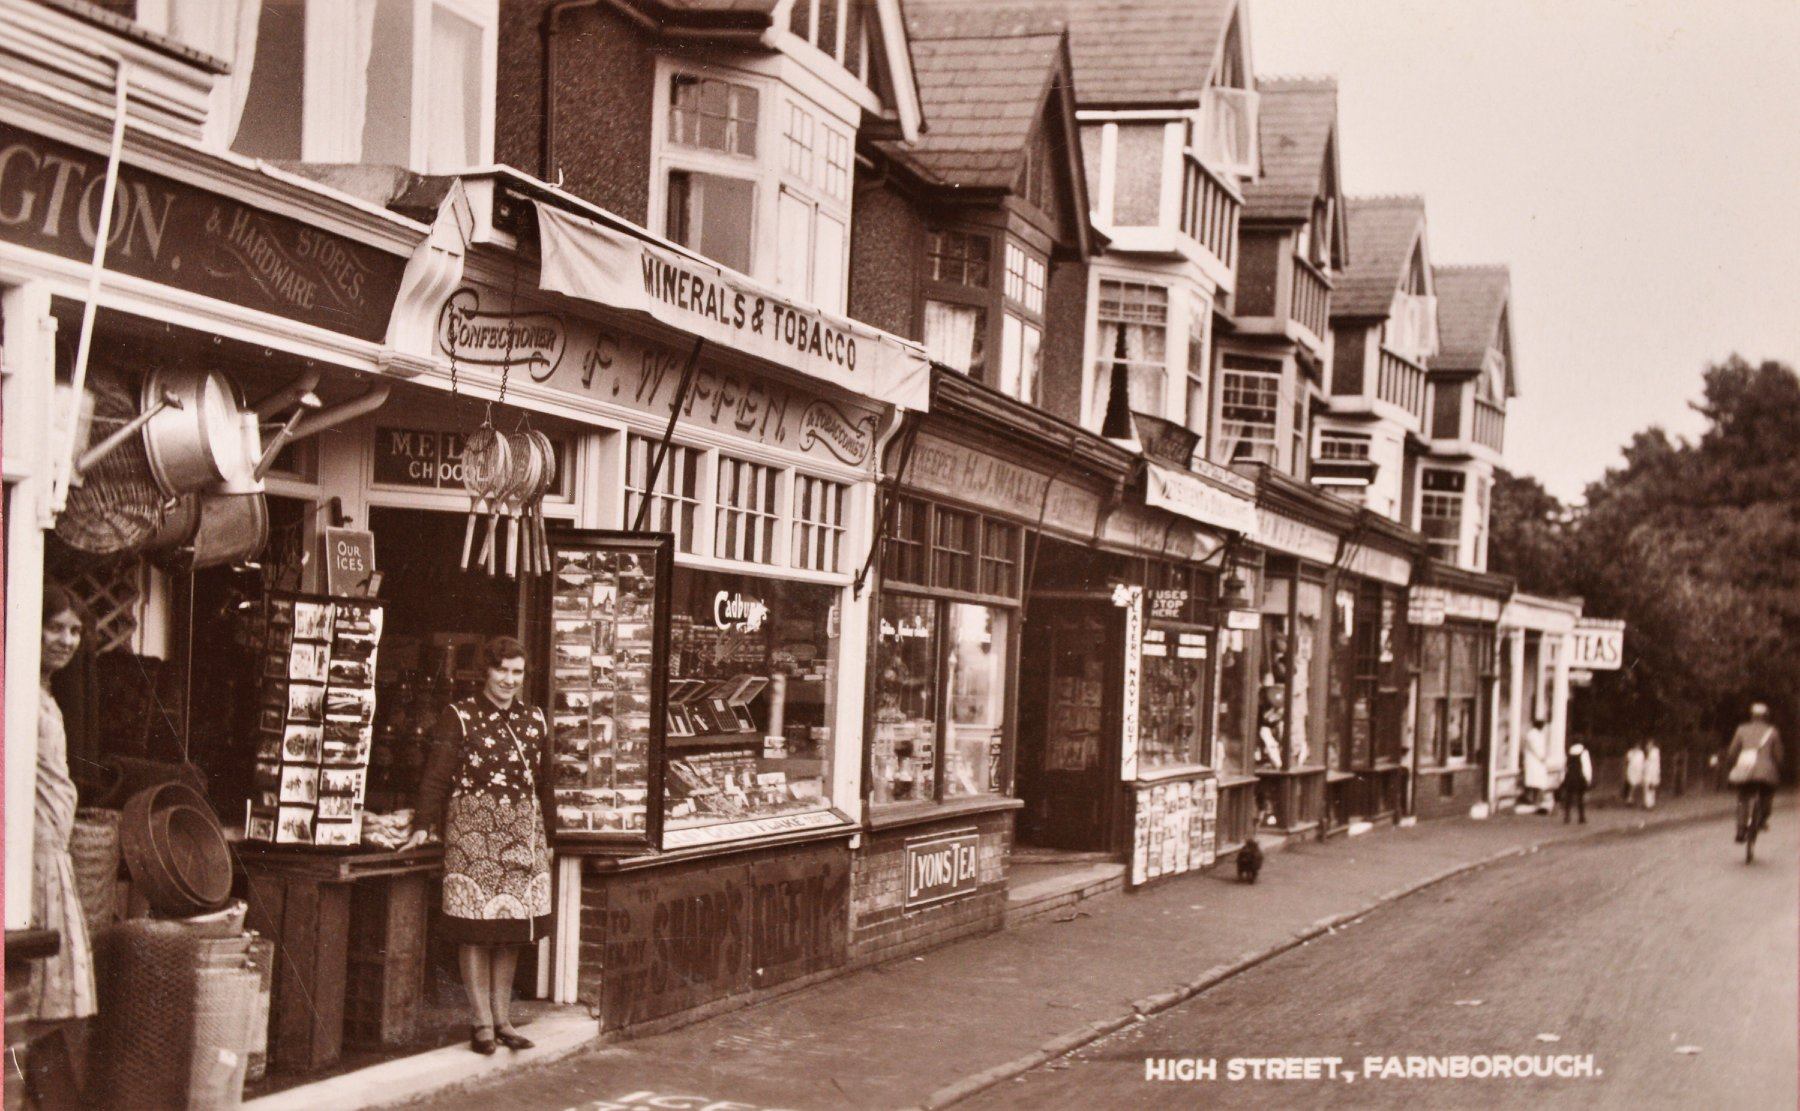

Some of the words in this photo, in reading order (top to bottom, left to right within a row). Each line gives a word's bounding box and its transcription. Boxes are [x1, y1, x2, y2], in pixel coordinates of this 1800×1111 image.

[230, 210, 317, 311] HARDWARE
[641, 254, 746, 328] MINERALS
[751, 297, 765, 333] &
[773, 304, 858, 372] TOBACCO
[447, 311, 557, 353] CONFECTIONER
[635, 345, 786, 443] WFFEN.
[391, 431, 464, 459] MEL
[408, 461, 495, 482] CHOCOL
[337, 540, 361, 557] OUR
[337, 555, 364, 571] ICES
[1151, 608, 1179, 618] HERE
[1153, 599, 1184, 609] STOP
[1573, 633, 1618, 663] TEAS
[1128, 668, 1137, 707] NAVY
[1126, 714, 1135, 743] CUT
[950, 842, 976, 888] TEA
